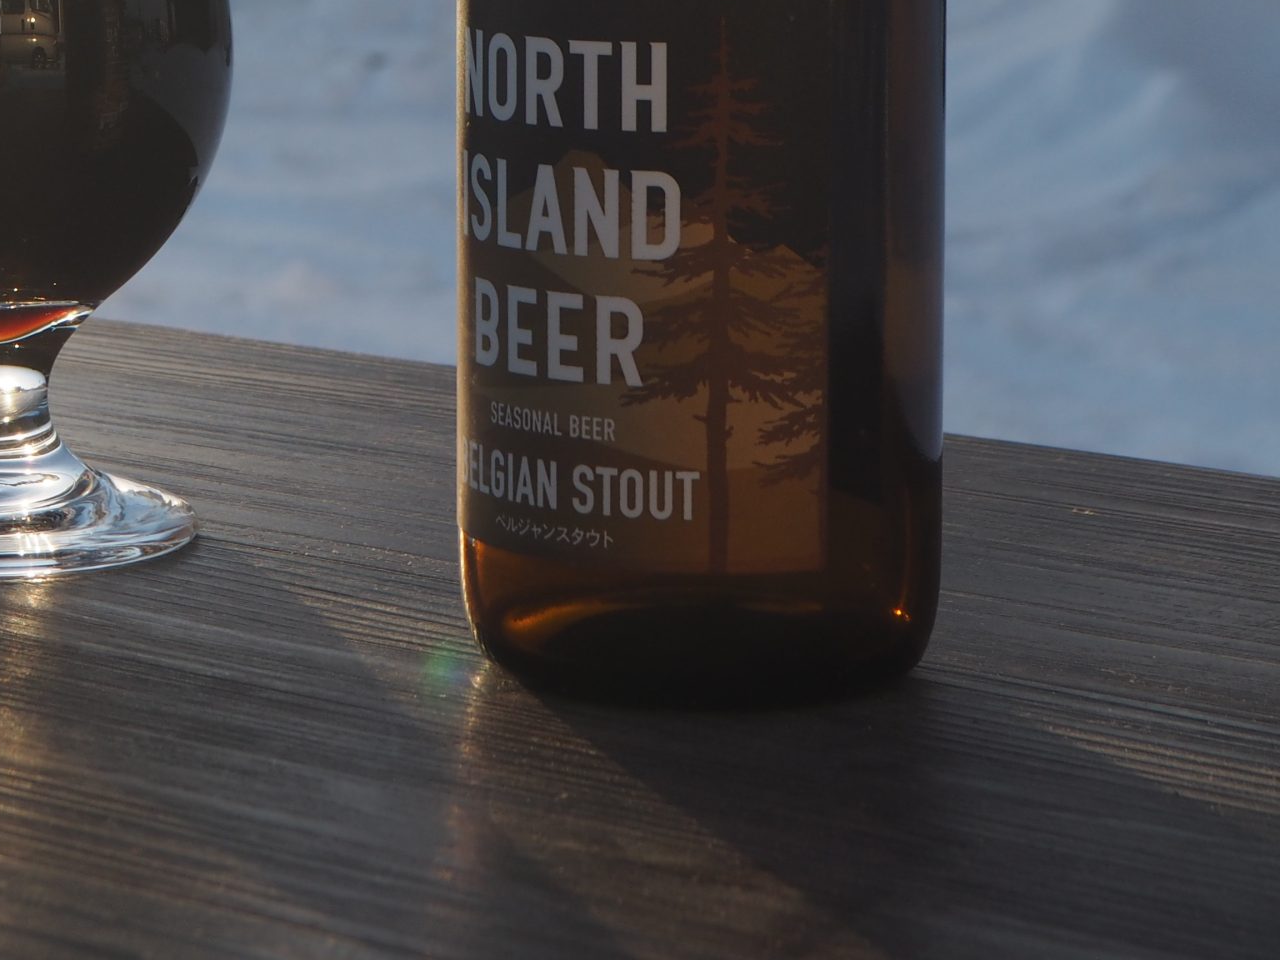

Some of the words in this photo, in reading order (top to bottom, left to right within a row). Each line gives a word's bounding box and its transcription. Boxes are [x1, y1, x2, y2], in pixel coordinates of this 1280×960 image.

[465, 26, 667, 132] NORTH
[463, 149, 681, 260] ISLAND
[475, 277, 643, 387] BEER
[490, 401, 562, 436] SEASONAL
[569, 414, 615, 441] BEER
[495, 514, 614, 548] ベルジャンスタウト
[572, 464, 700, 520] STOUT
